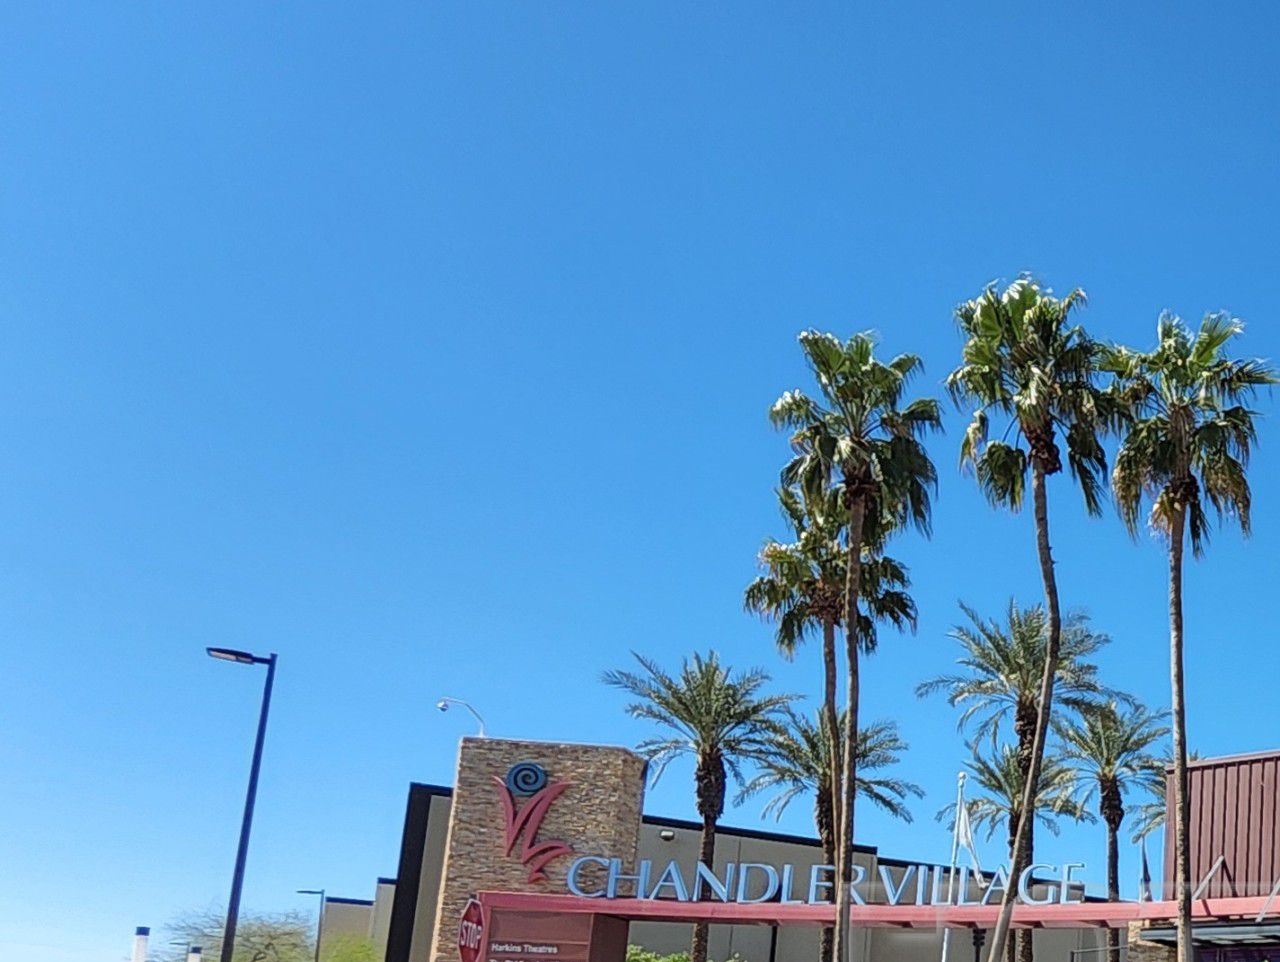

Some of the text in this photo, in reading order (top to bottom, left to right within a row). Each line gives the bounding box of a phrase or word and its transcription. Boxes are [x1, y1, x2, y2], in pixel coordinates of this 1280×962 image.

[566, 855, 1086, 906] CHANDLER VILLAGE
[460, 919, 483, 949] STOP
[491, 943, 558, 954] Harkins Theatres
